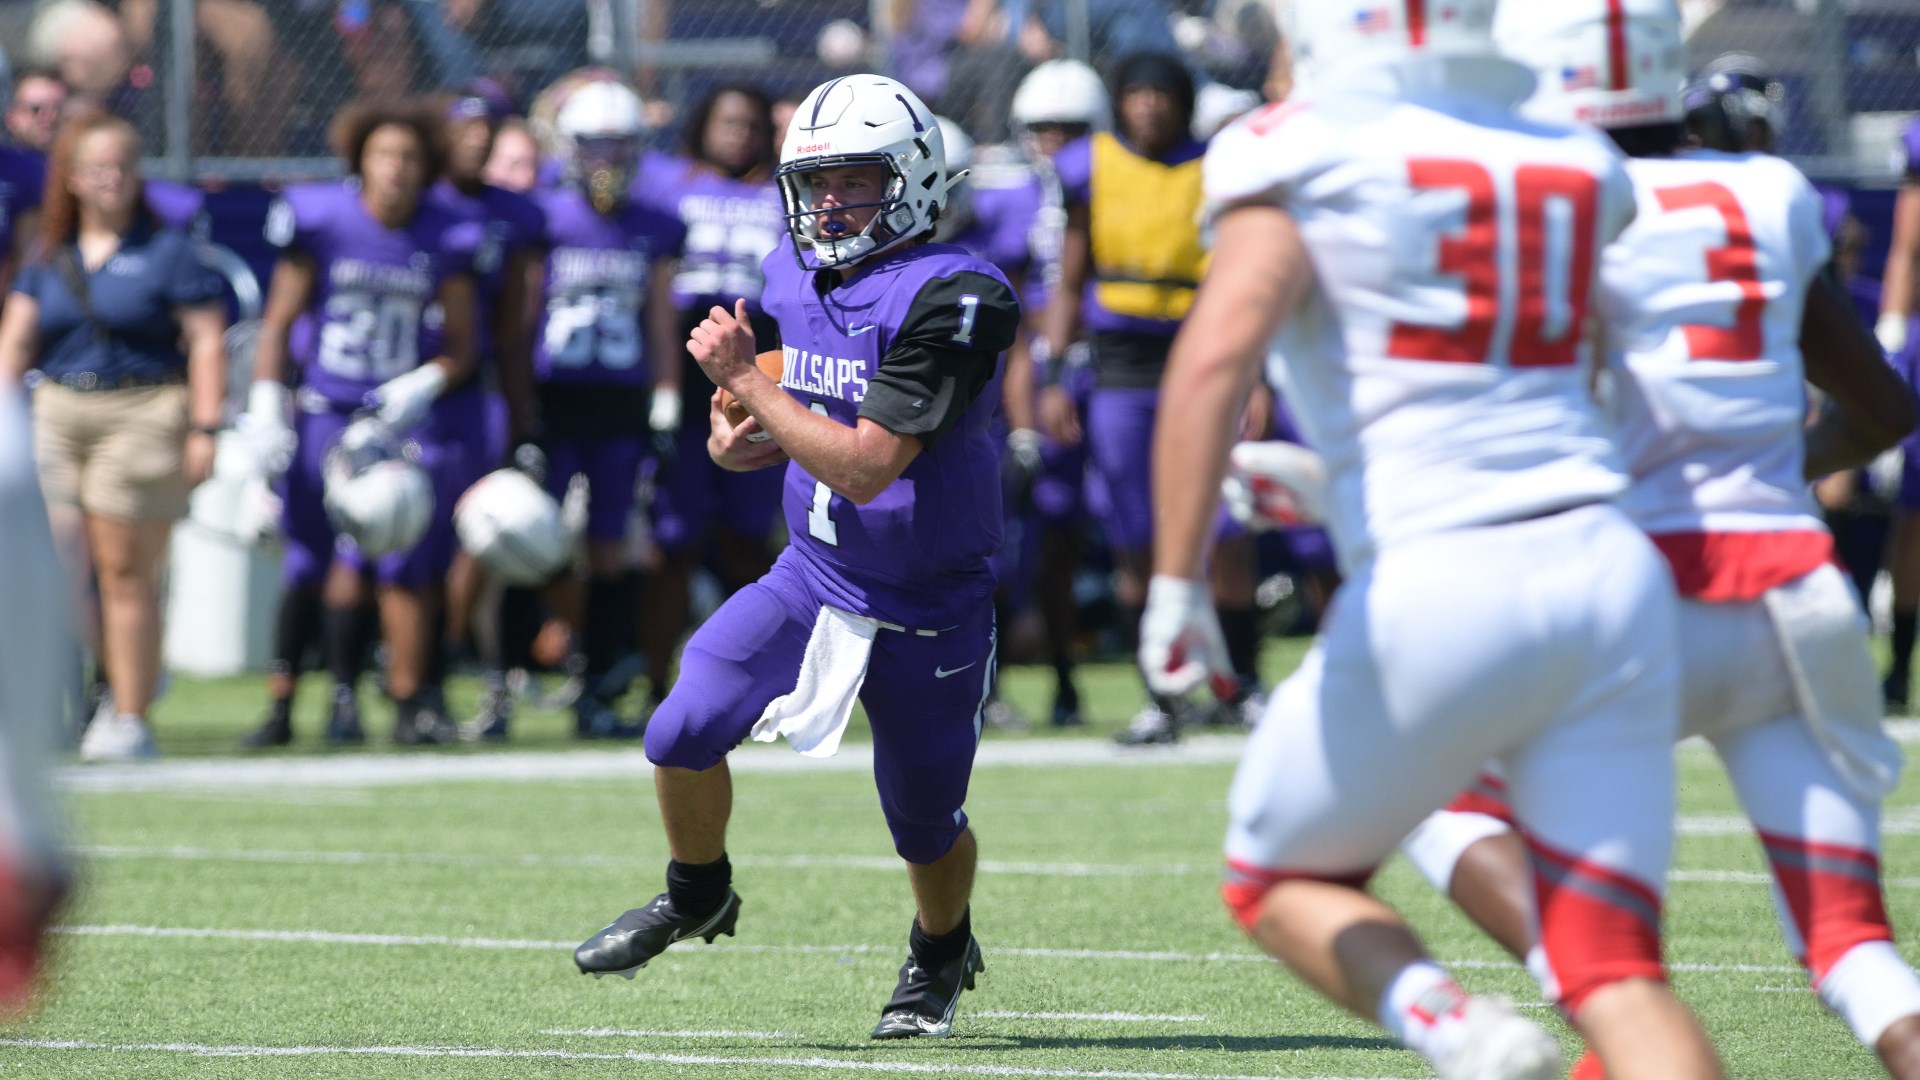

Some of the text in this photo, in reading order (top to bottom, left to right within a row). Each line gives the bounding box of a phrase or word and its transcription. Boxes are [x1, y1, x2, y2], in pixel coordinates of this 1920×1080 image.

[895, 94, 925, 132] 1
[796, 142, 831, 154] Riddell
[1388, 158, 1597, 367] 30
[1653, 181, 1766, 362] 3
[950, 295, 978, 344] 1
